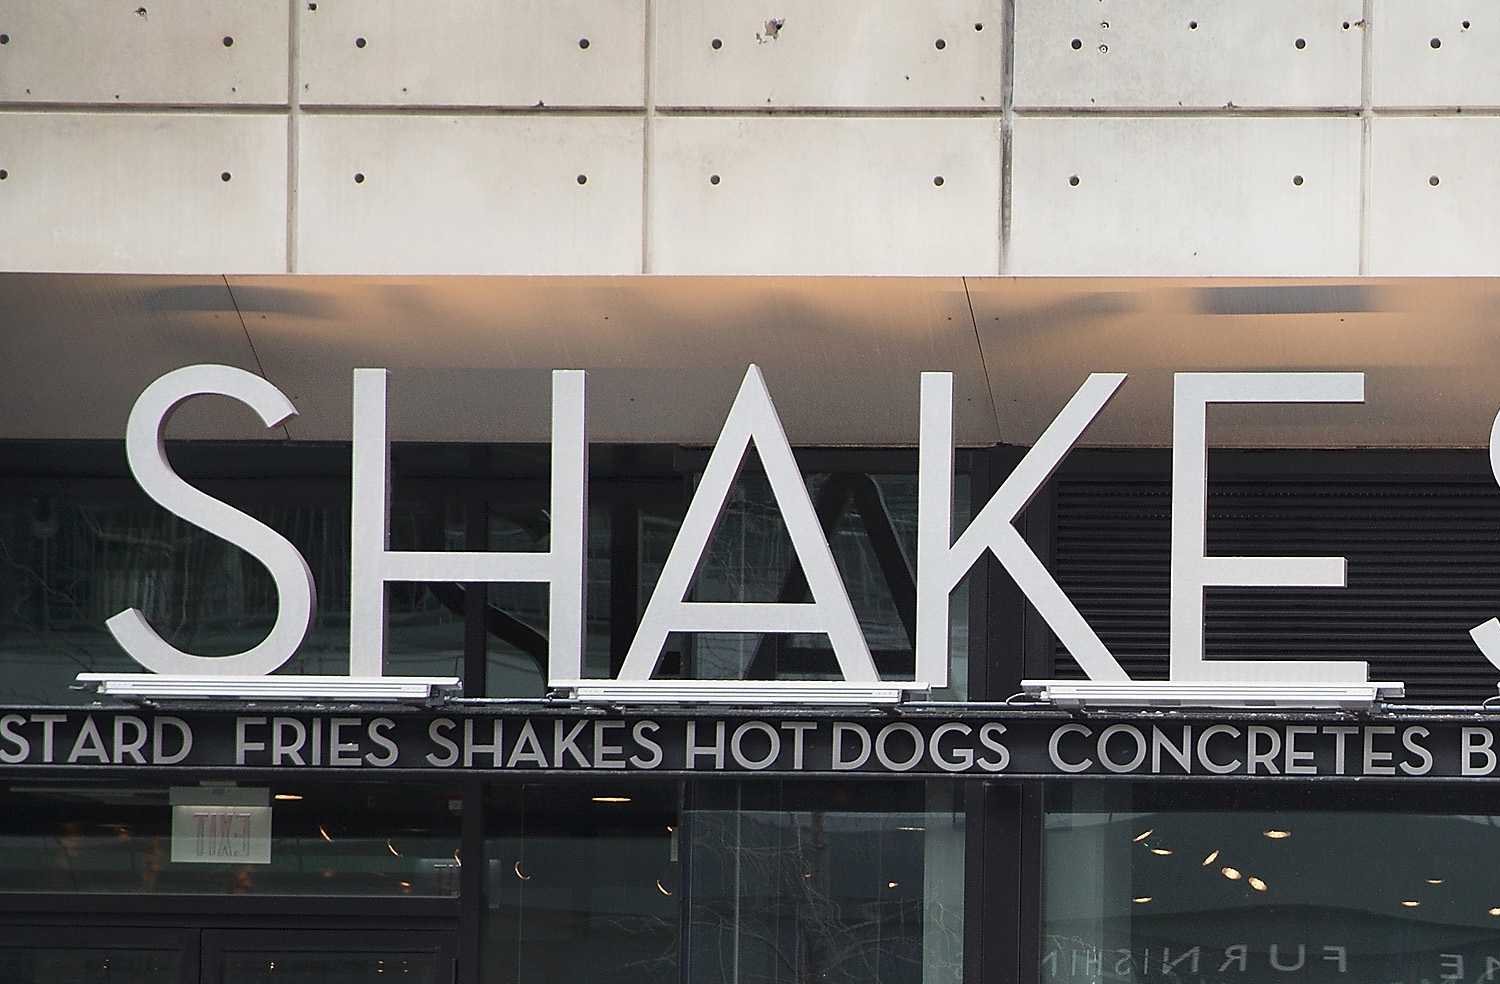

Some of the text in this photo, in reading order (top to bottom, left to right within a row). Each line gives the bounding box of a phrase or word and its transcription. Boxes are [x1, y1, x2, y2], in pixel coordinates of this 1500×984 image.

[105, 363, 1369, 683] SHAKE
[0, 714, 194, 764] STARD
[236, 717, 399, 767] FRIES
[426, 718, 663, 770] SHAKES
[685, 721, 818, 770] HOT
[831, 722, 1010, 773] DOGS
[1048, 724, 1434, 776] CONCRETES
